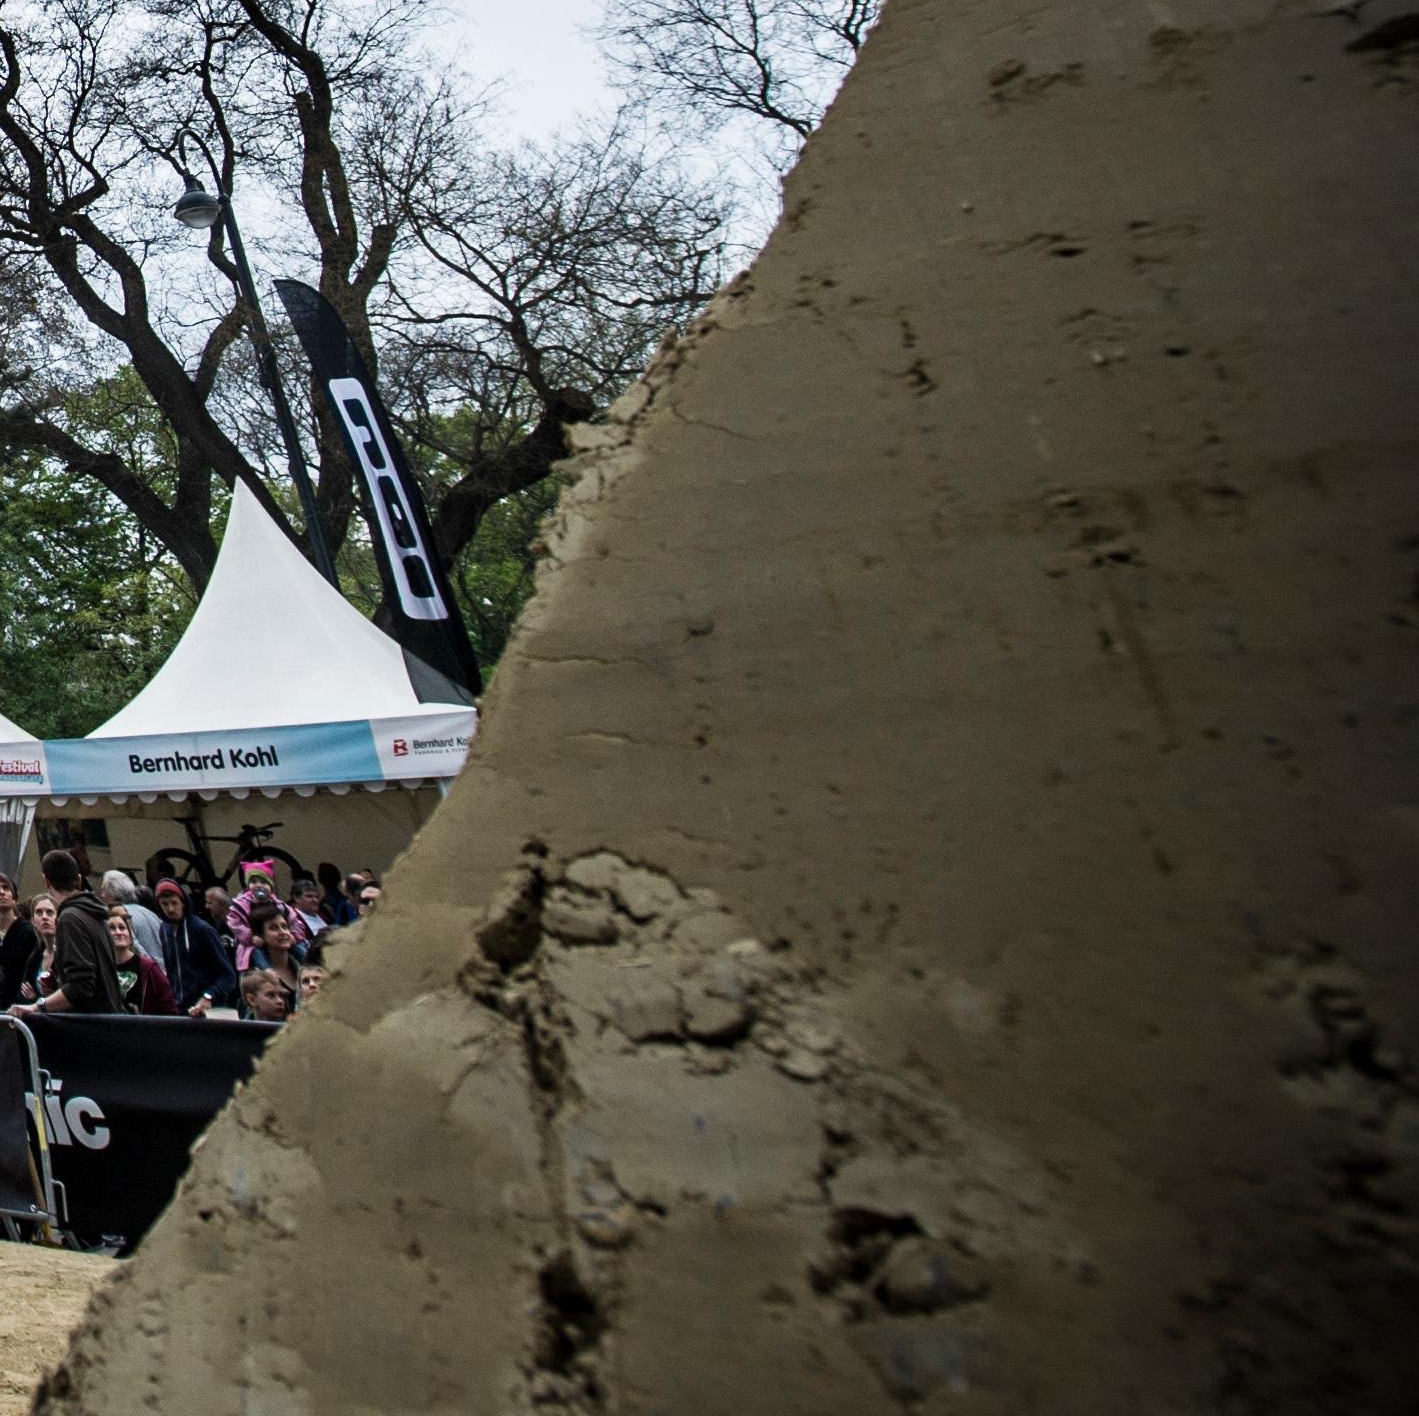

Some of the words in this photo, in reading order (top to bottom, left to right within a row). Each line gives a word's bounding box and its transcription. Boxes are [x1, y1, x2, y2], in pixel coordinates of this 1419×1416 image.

[413, 737, 454, 749] Bernhard
[129, 749, 224, 774] Bernhard
[228, 745, 279, 768] Kohl
